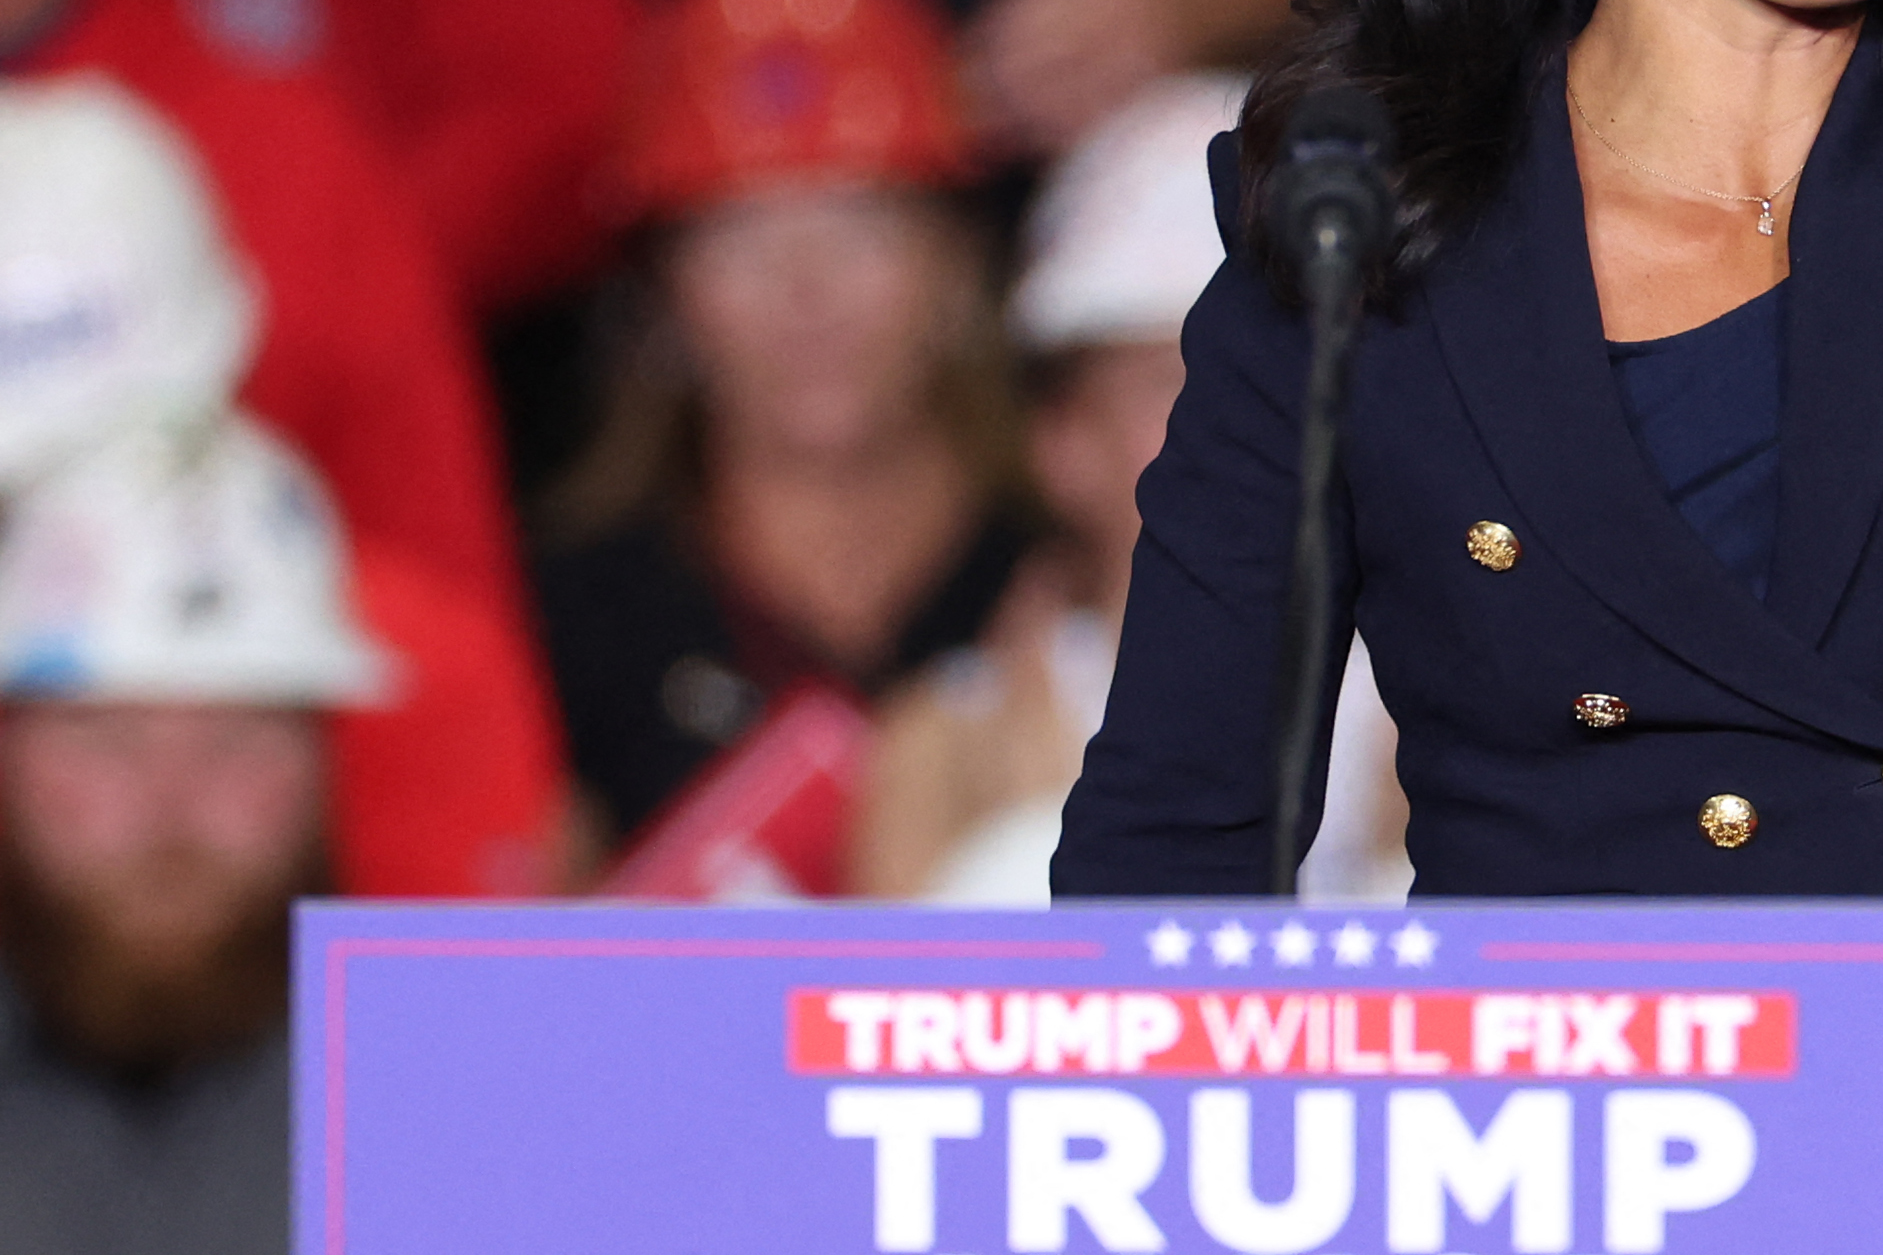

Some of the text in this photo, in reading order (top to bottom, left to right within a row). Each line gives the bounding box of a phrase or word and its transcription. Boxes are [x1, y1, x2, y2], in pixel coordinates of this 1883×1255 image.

[827, 991, 1758, 1076] TRUMP WILL FIX IT
[826, 1086, 1758, 1253] TRUMP
